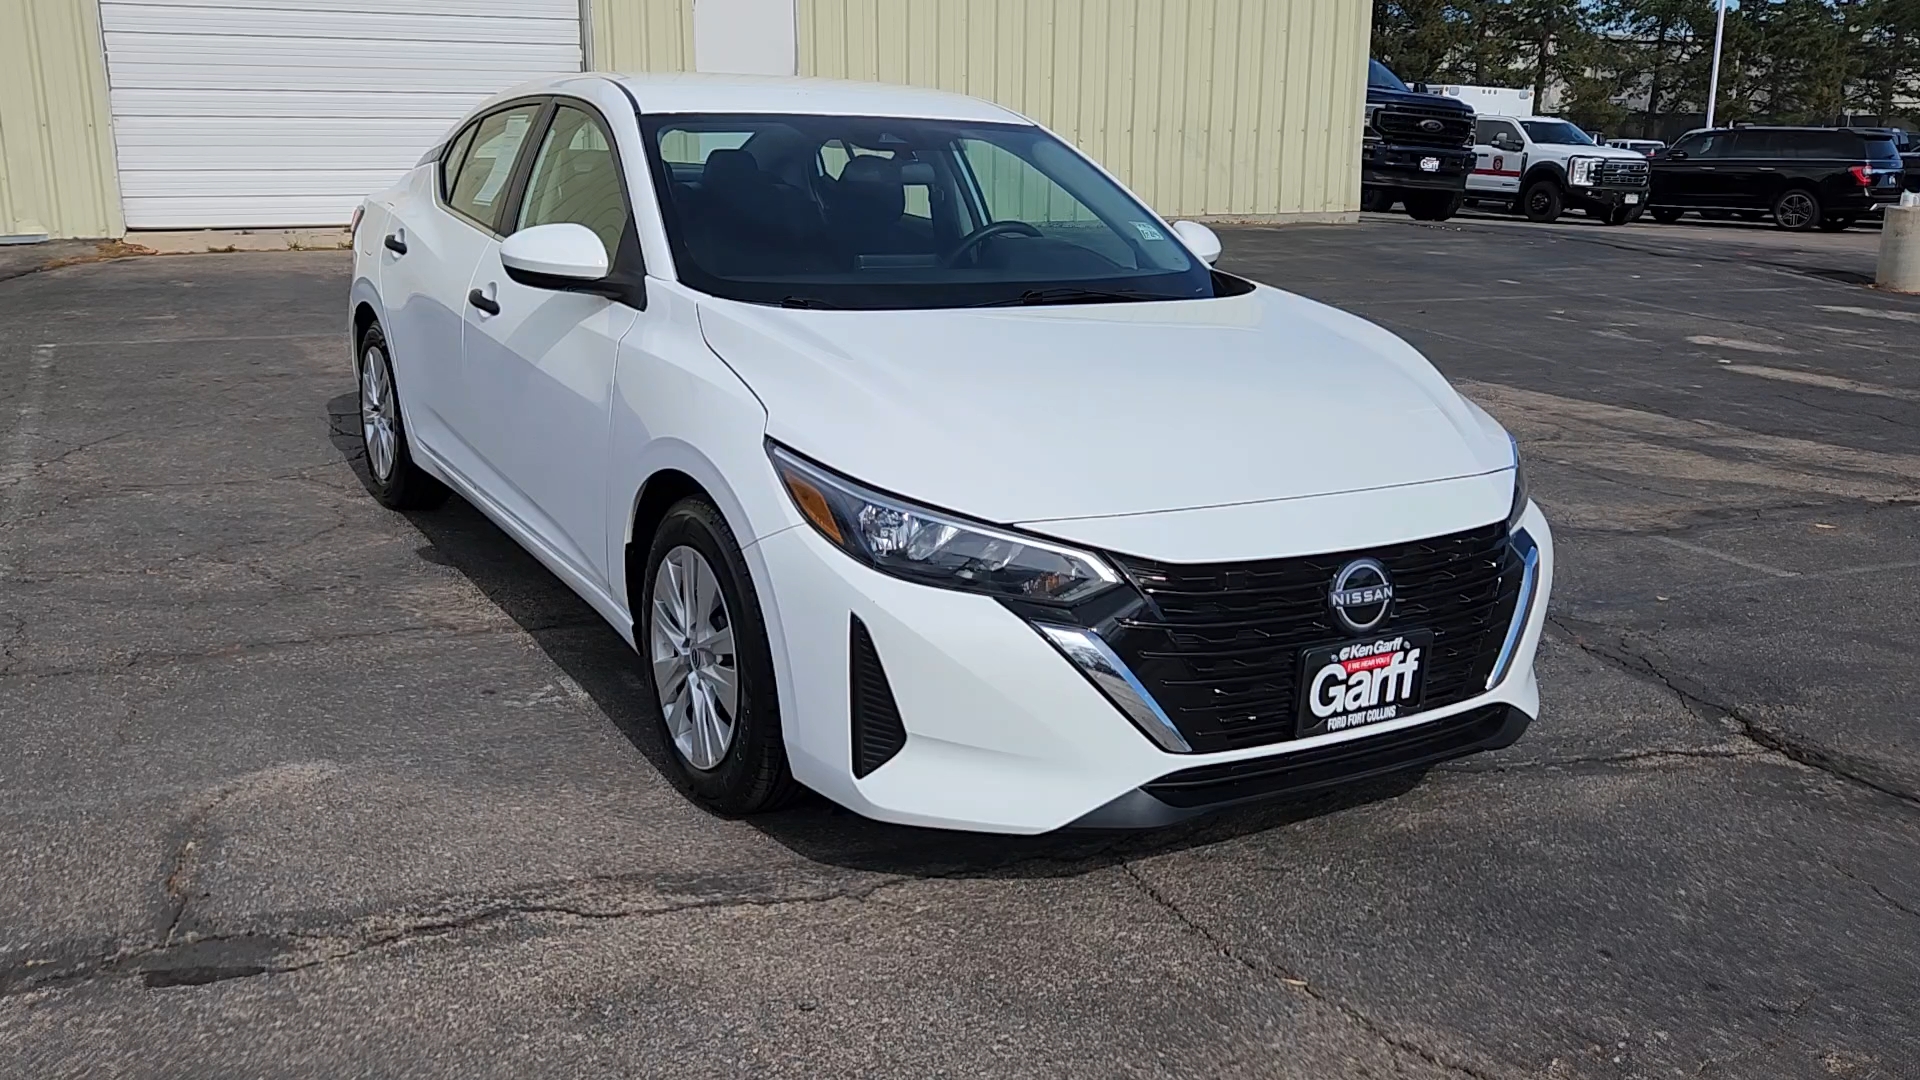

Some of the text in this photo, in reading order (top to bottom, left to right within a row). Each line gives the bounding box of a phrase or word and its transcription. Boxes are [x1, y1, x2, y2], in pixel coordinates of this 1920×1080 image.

[1332, 586, 1393, 606] NISSAN
[1350, 637, 1403, 659] Ken Garff
[1309, 648, 1421, 718] Garff
[1327, 705, 1397, 732] FORD FORT COLLINS
